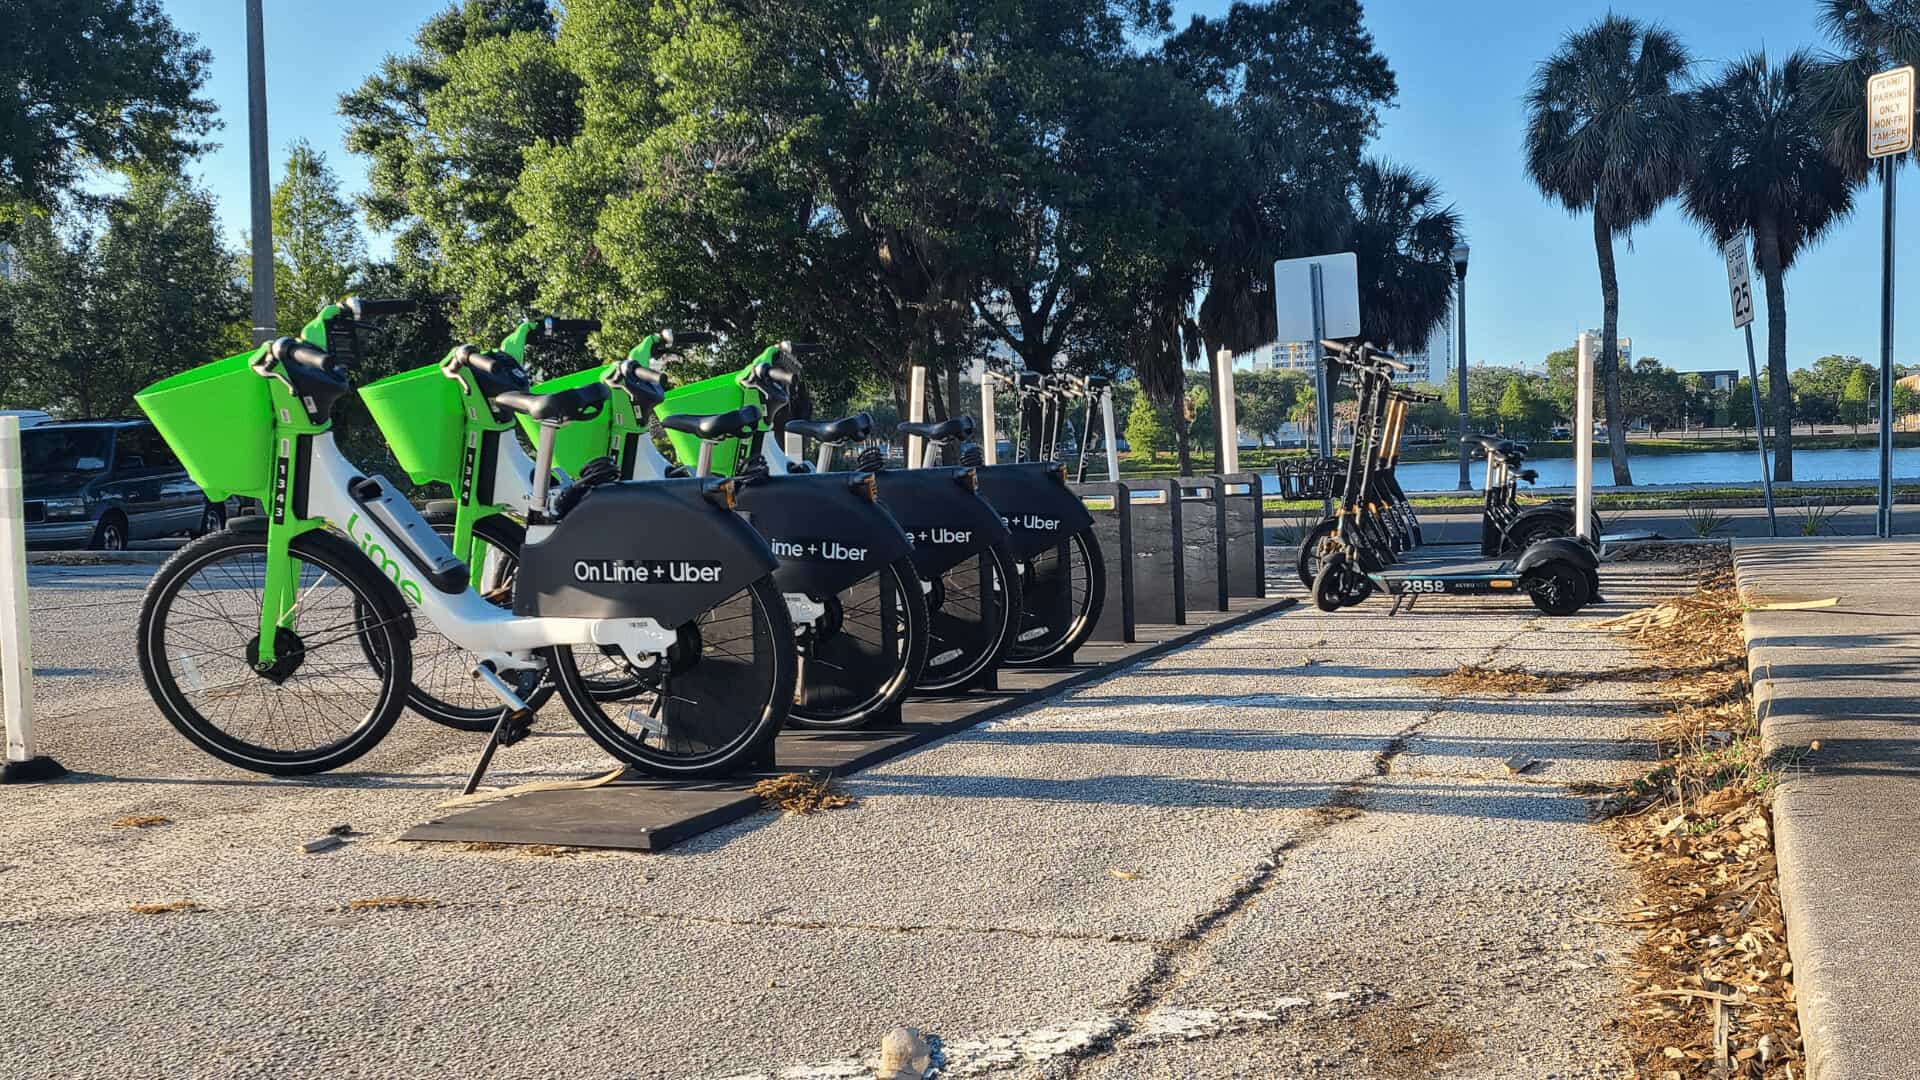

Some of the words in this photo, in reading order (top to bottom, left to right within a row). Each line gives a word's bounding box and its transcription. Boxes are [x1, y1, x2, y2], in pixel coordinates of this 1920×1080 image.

[1873, 88, 1907, 102] PARKING
[1880, 104, 1900, 115] ONLY
[1729, 243, 1744, 263] SPEED
[1731, 262, 1745, 279] LIMIT
[1733, 282, 1750, 318] 25
[275, 465, 286, 517] 1343
[1023, 515, 1060, 530] Uber
[931, 528, 972, 543] Uber
[771, 538, 803, 557] ime
[822, 541, 868, 561] Uber
[669, 562, 722, 582] Uber
[1402, 580, 1445, 593] 2858
